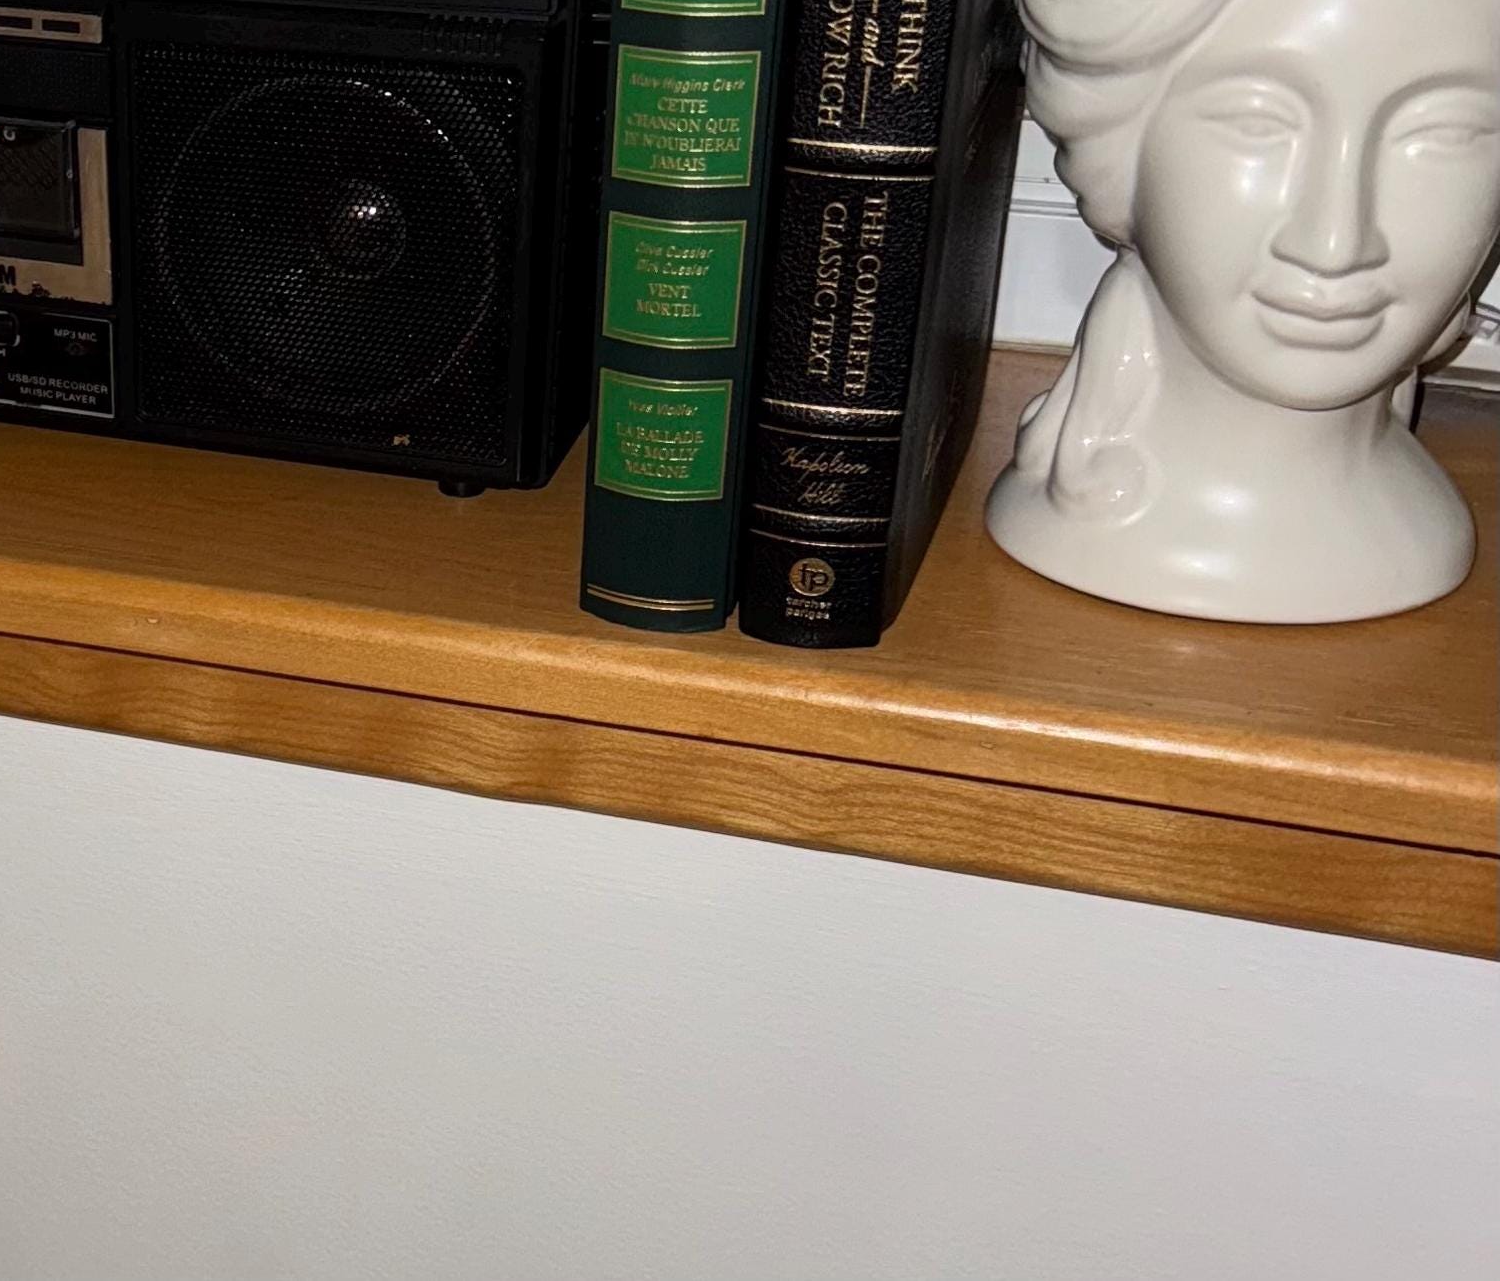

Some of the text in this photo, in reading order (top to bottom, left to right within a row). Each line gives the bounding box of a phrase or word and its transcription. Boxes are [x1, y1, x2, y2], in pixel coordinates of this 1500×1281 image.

[817, 51, 850, 128] RICH
[657, 96, 708, 114] CETTE
[705, 117, 740, 135] QUE
[650, 154, 707, 171] JAMAIS
[649, 283, 692, 300] VENT
[807, 202, 848, 383] CLASSIC TEXT
[843, 191, 888, 397] THE COMPLETE
[636, 298, 702, 318] MORTEL
[53, 328, 98, 342] MP3 MIC
[48, 377, 109, 395] RECORDER
[20, 386, 97, 405] MUSIC PLAYER
